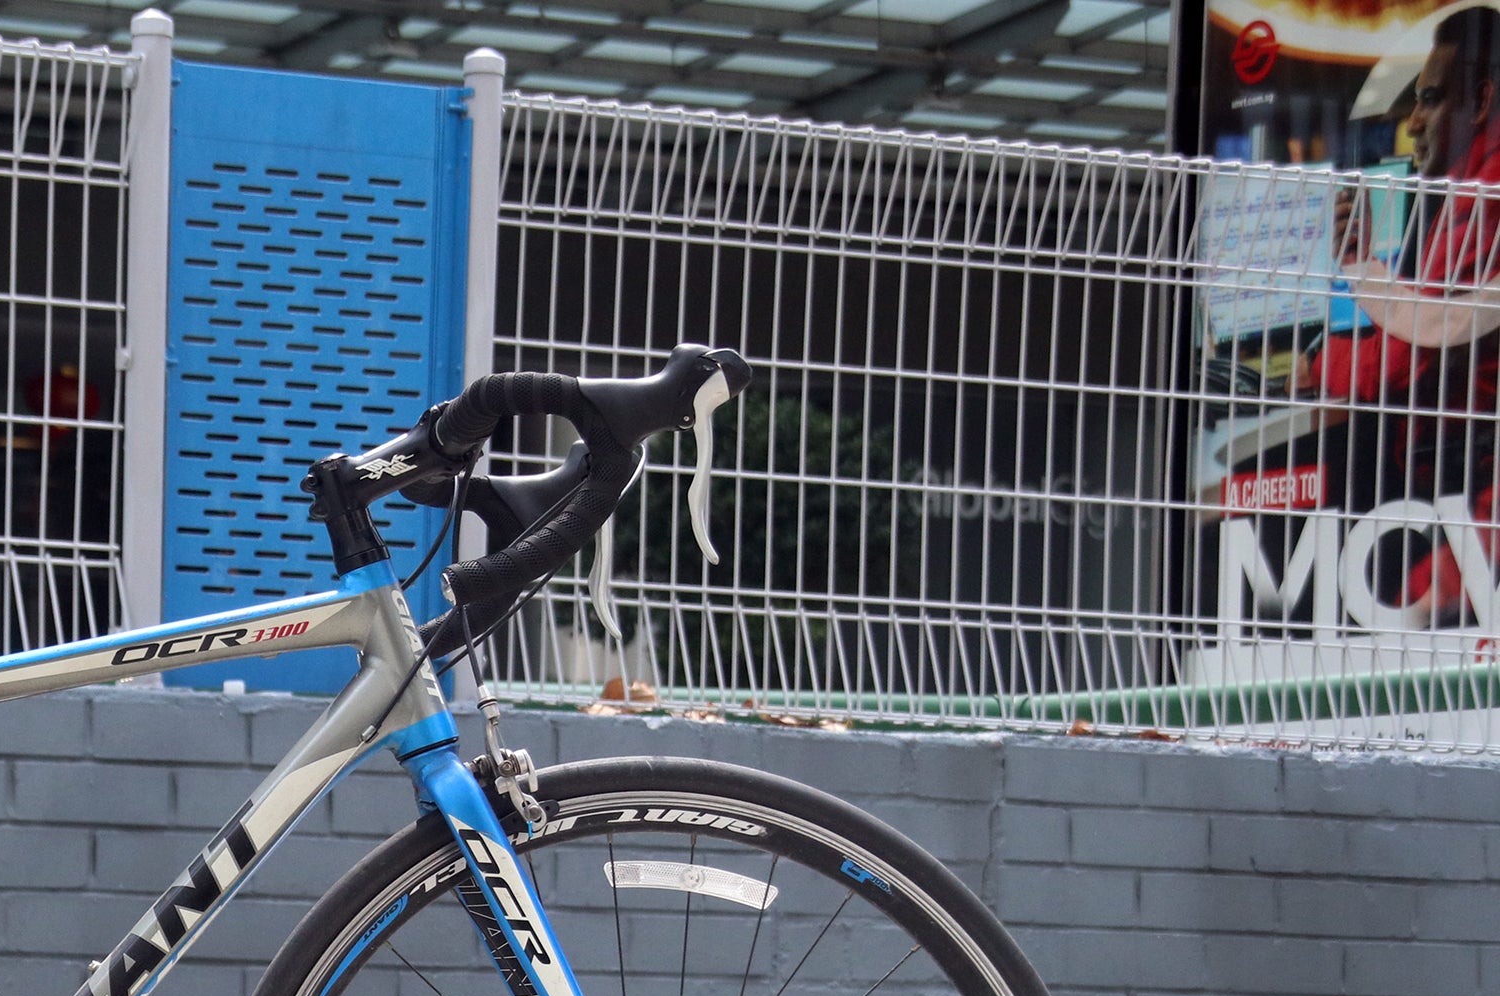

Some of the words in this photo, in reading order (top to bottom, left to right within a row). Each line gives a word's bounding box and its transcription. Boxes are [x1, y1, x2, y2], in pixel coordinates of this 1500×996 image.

[1242, 476, 1296, 508] CAREER
[1300, 473, 1319, 502] TO
[111, 628, 248, 666] OCR
[248, 621, 309, 644] 3300
[606, 807, 768, 837] GIANT
[458, 828, 552, 966] OCR
